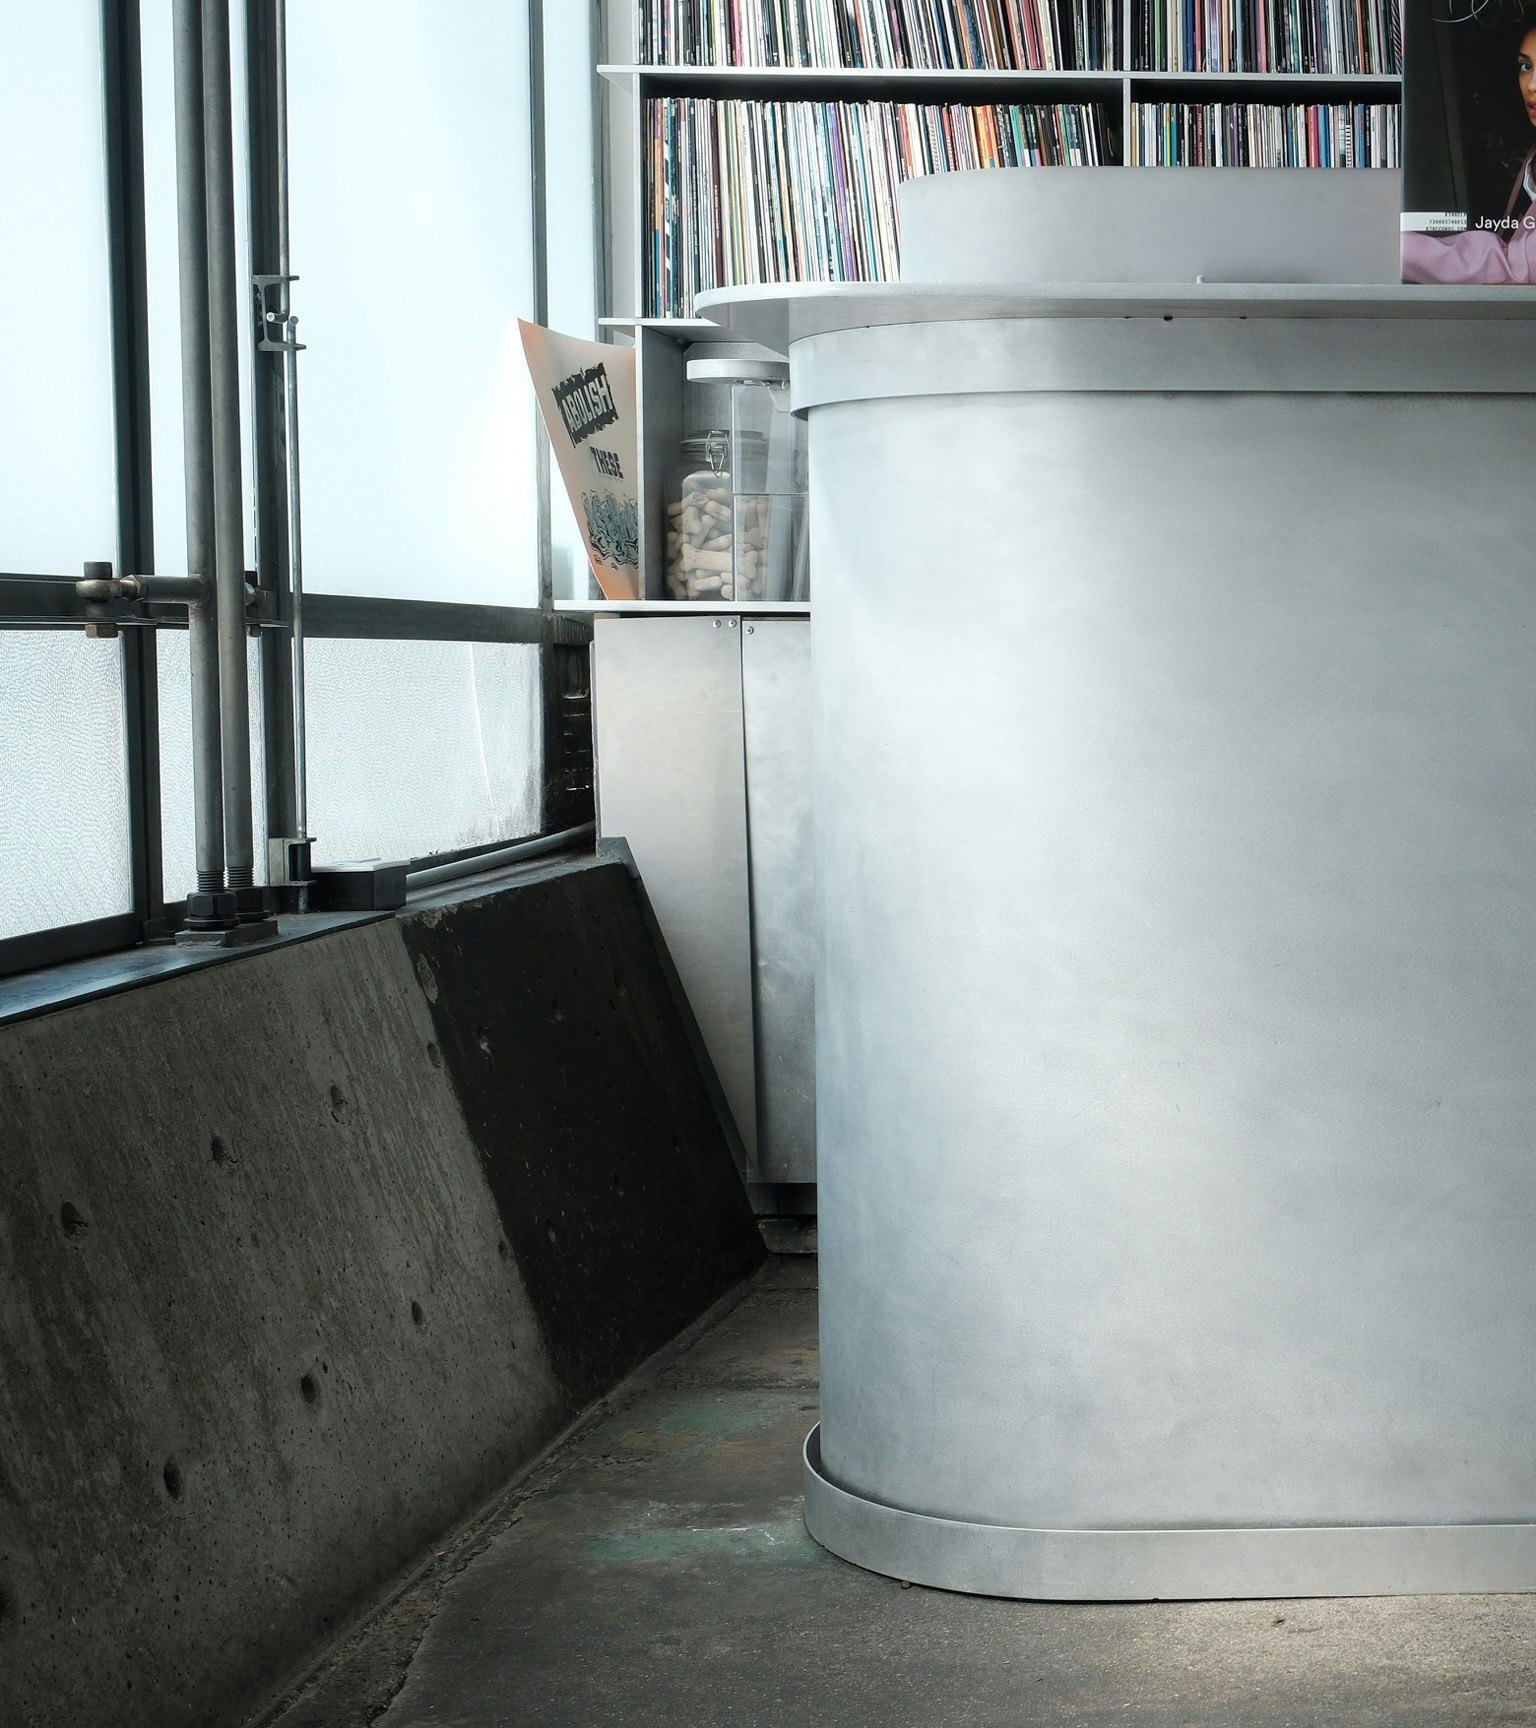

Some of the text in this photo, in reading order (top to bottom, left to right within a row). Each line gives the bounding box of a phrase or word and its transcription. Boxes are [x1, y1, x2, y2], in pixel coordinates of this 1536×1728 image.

[1475, 215, 1536, 232] Jayda G
[561, 374, 614, 433] ABOLISH
[589, 446, 624, 479] THESE
